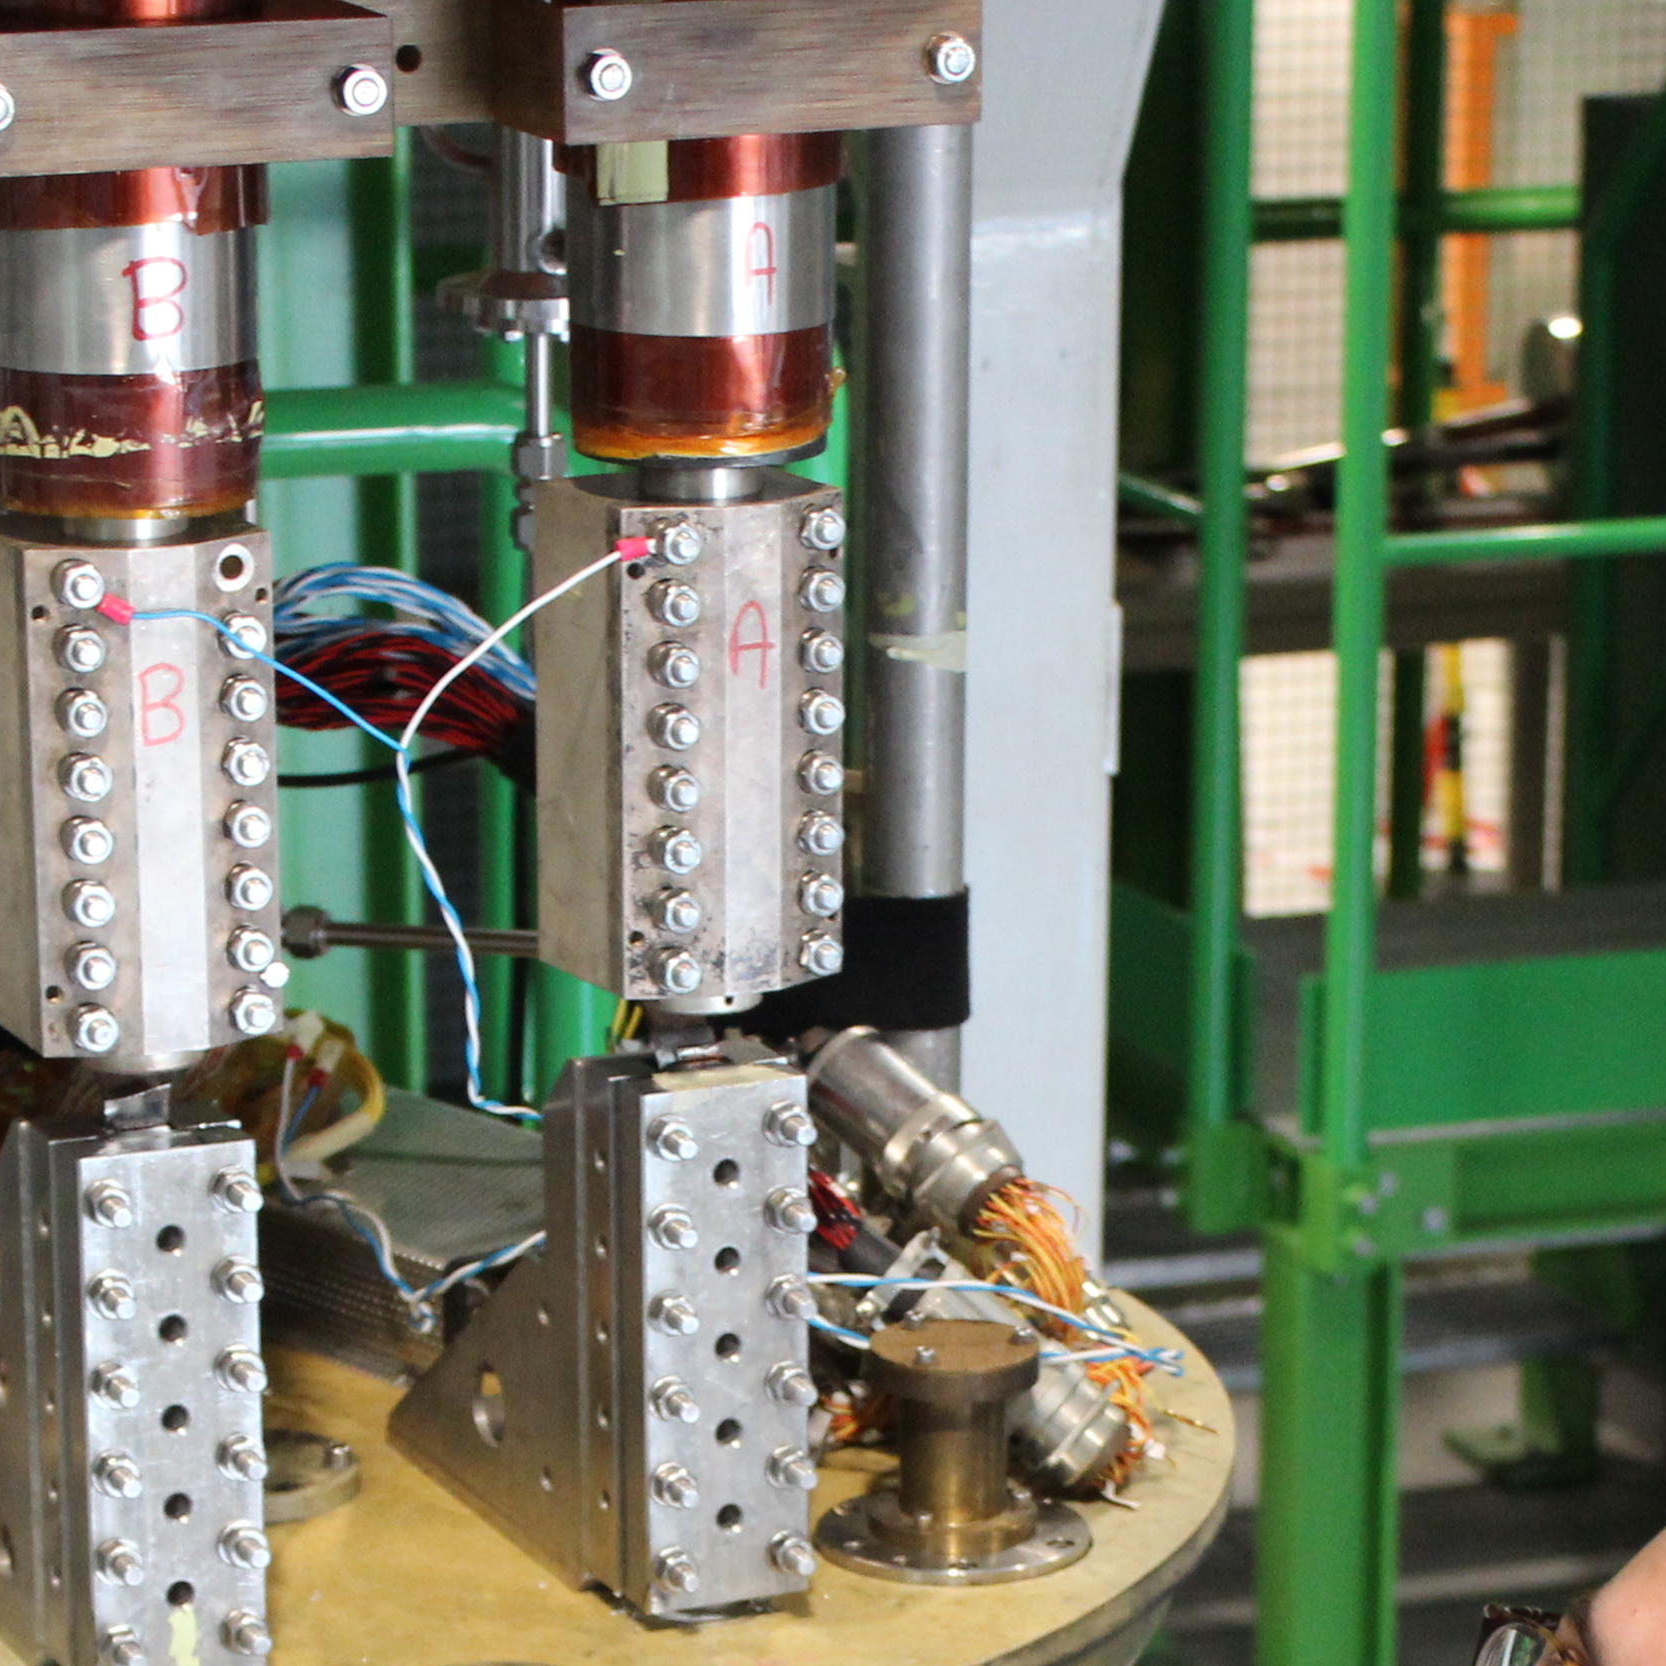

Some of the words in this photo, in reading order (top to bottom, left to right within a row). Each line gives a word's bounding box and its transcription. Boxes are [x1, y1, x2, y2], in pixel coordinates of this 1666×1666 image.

[120, 256, 189, 341] B
[744, 221, 778, 306] A
[728, 600, 777, 690] A
[137, 661, 186, 748] B
